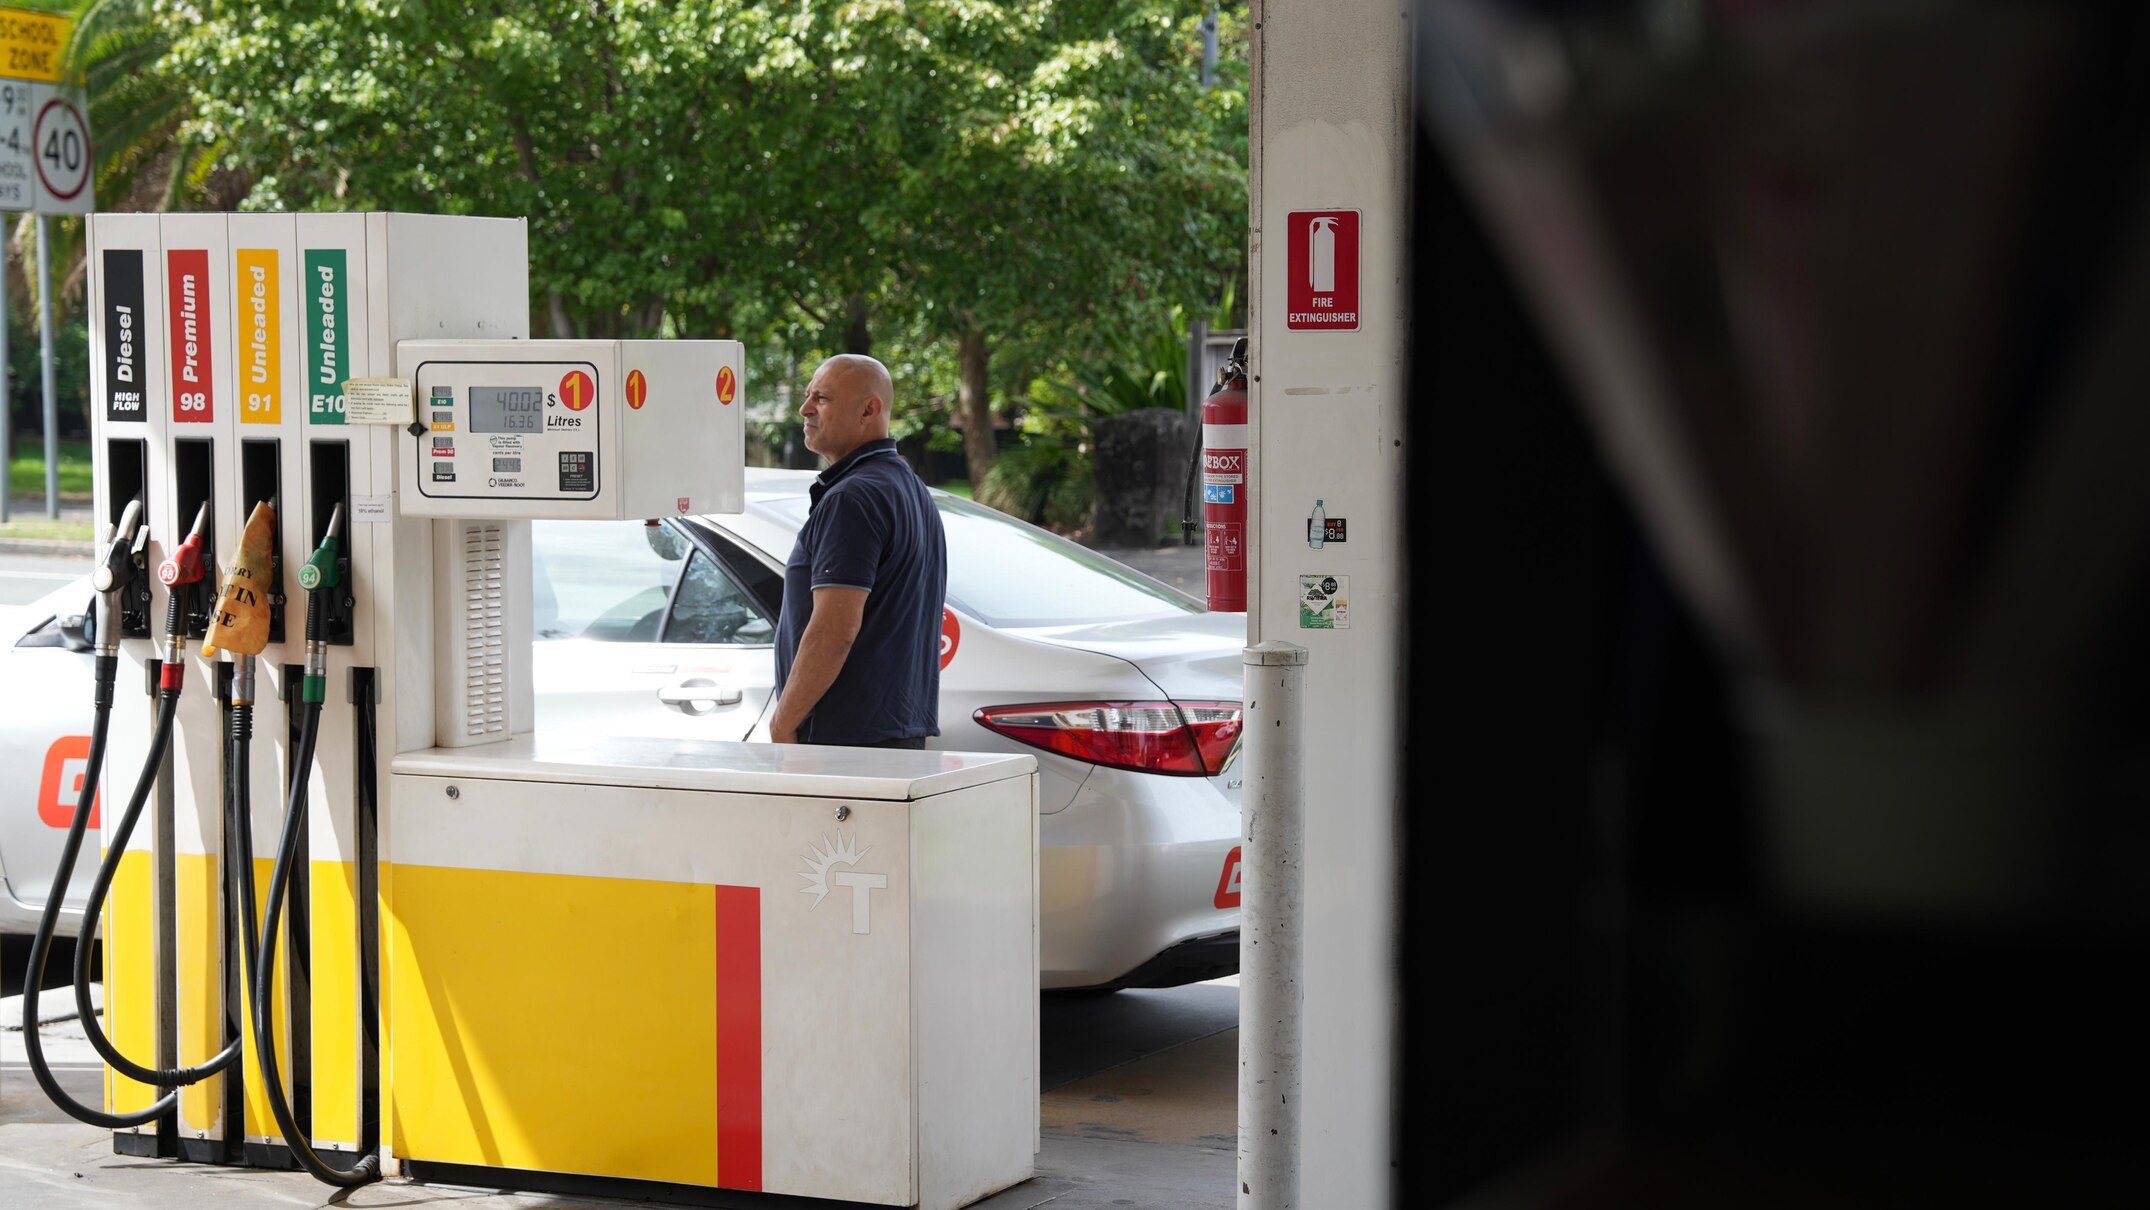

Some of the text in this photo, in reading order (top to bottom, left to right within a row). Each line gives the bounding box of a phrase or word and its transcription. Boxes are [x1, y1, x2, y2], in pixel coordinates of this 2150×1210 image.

[9, 46, 50, 74] ZONE
[44, 127, 80, 172] 40
[1312, 298, 1333, 308] FIRE
[250, 266, 268, 384] Unleaded
[318, 266, 336, 384] Unleaded
[1290, 313, 1356, 322] EXTINGUISHER
[182, 274, 199, 384] Premium
[116, 305, 133, 383] Diesel
[566, 373, 580, 409] 1
[630, 372, 639, 408] 1
[720, 367, 732, 402] 2
[113, 402, 140, 411] FLOW
[114, 392, 140, 402] HIGH
[180, 392, 206, 412] 98
[248, 393, 272, 412] 91
[312, 394, 346, 413] E10
[496, 392, 542, 412] 40.02
[547, 393, 556, 408] $
[504, 416, 534, 428] 16.36
[547, 415, 582, 426] Litres
[161, 569, 174, 580] 98
[303, 572, 316, 584] 94
[235, 586, 257, 608] IN
[212, 610, 237, 628] SE
